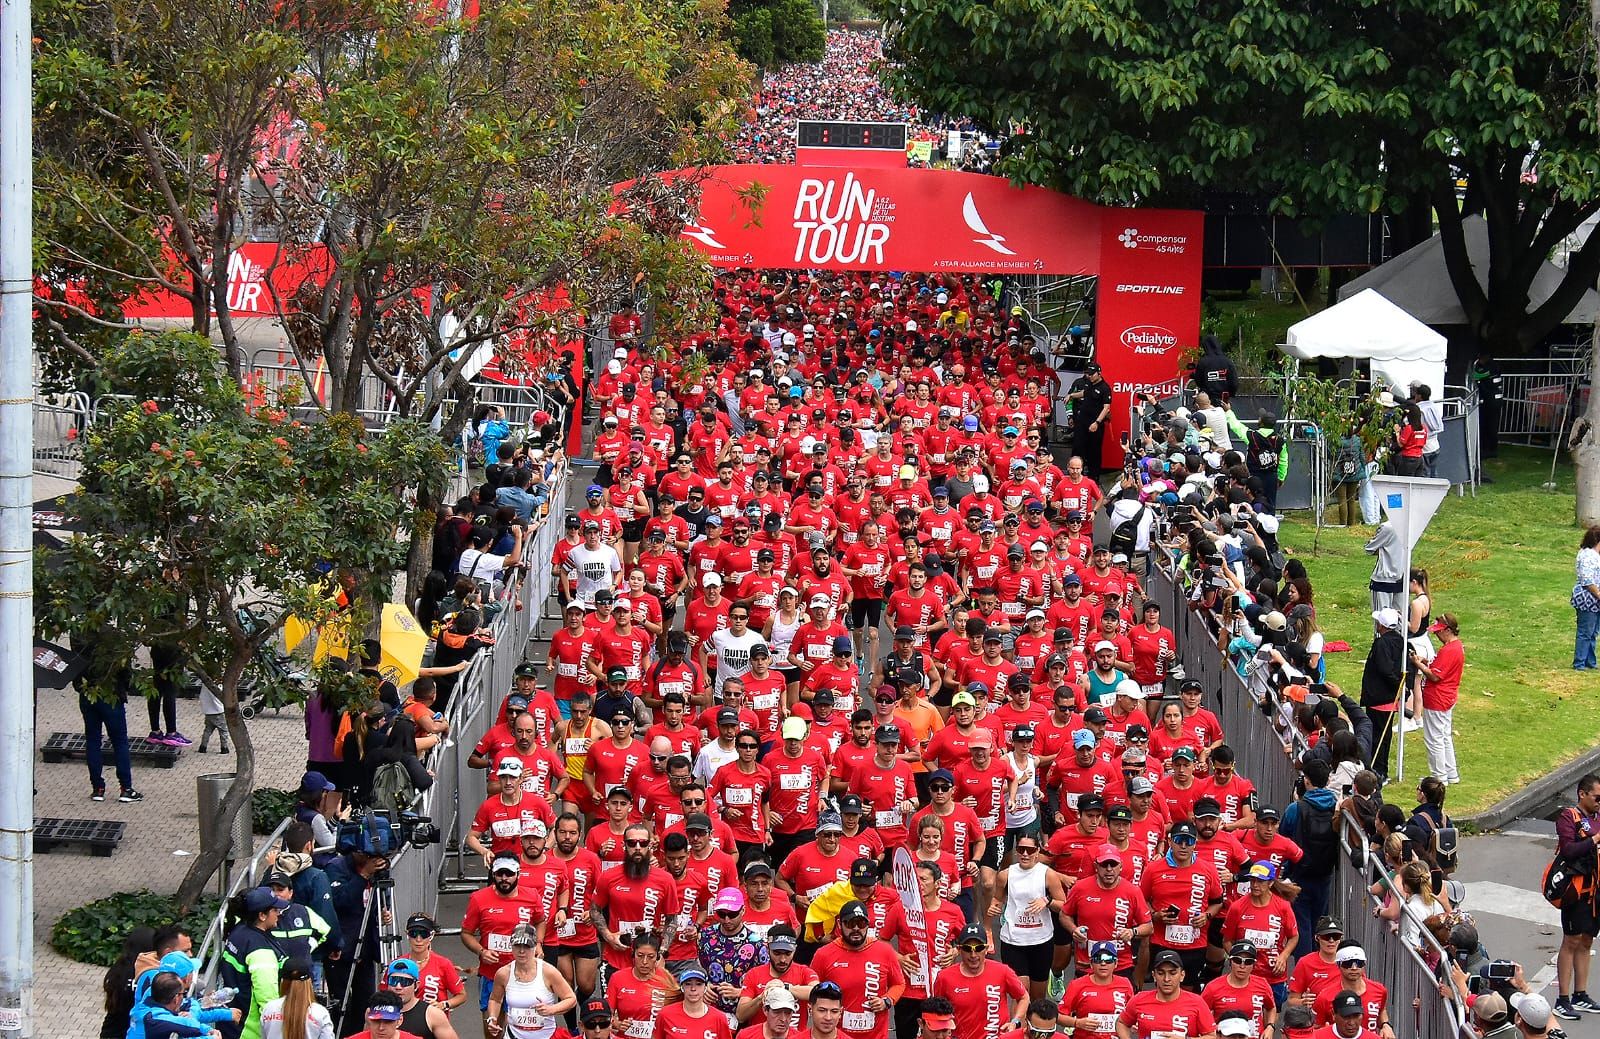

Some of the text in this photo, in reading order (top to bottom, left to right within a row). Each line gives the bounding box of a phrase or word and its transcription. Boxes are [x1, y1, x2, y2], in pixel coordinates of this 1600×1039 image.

[794, 172, 875, 224] RUN
[793, 222, 890, 264] TOUR
[1136, 236, 1186, 244] compensar
[1116, 284, 1184, 294] SPORTLINE
[1126, 332, 1175, 346] Pedialyte
[1134, 346, 1164, 354] Active
[517, 1016, 537, 1024] 2796
[849, 1019, 867, 1028] 1761
